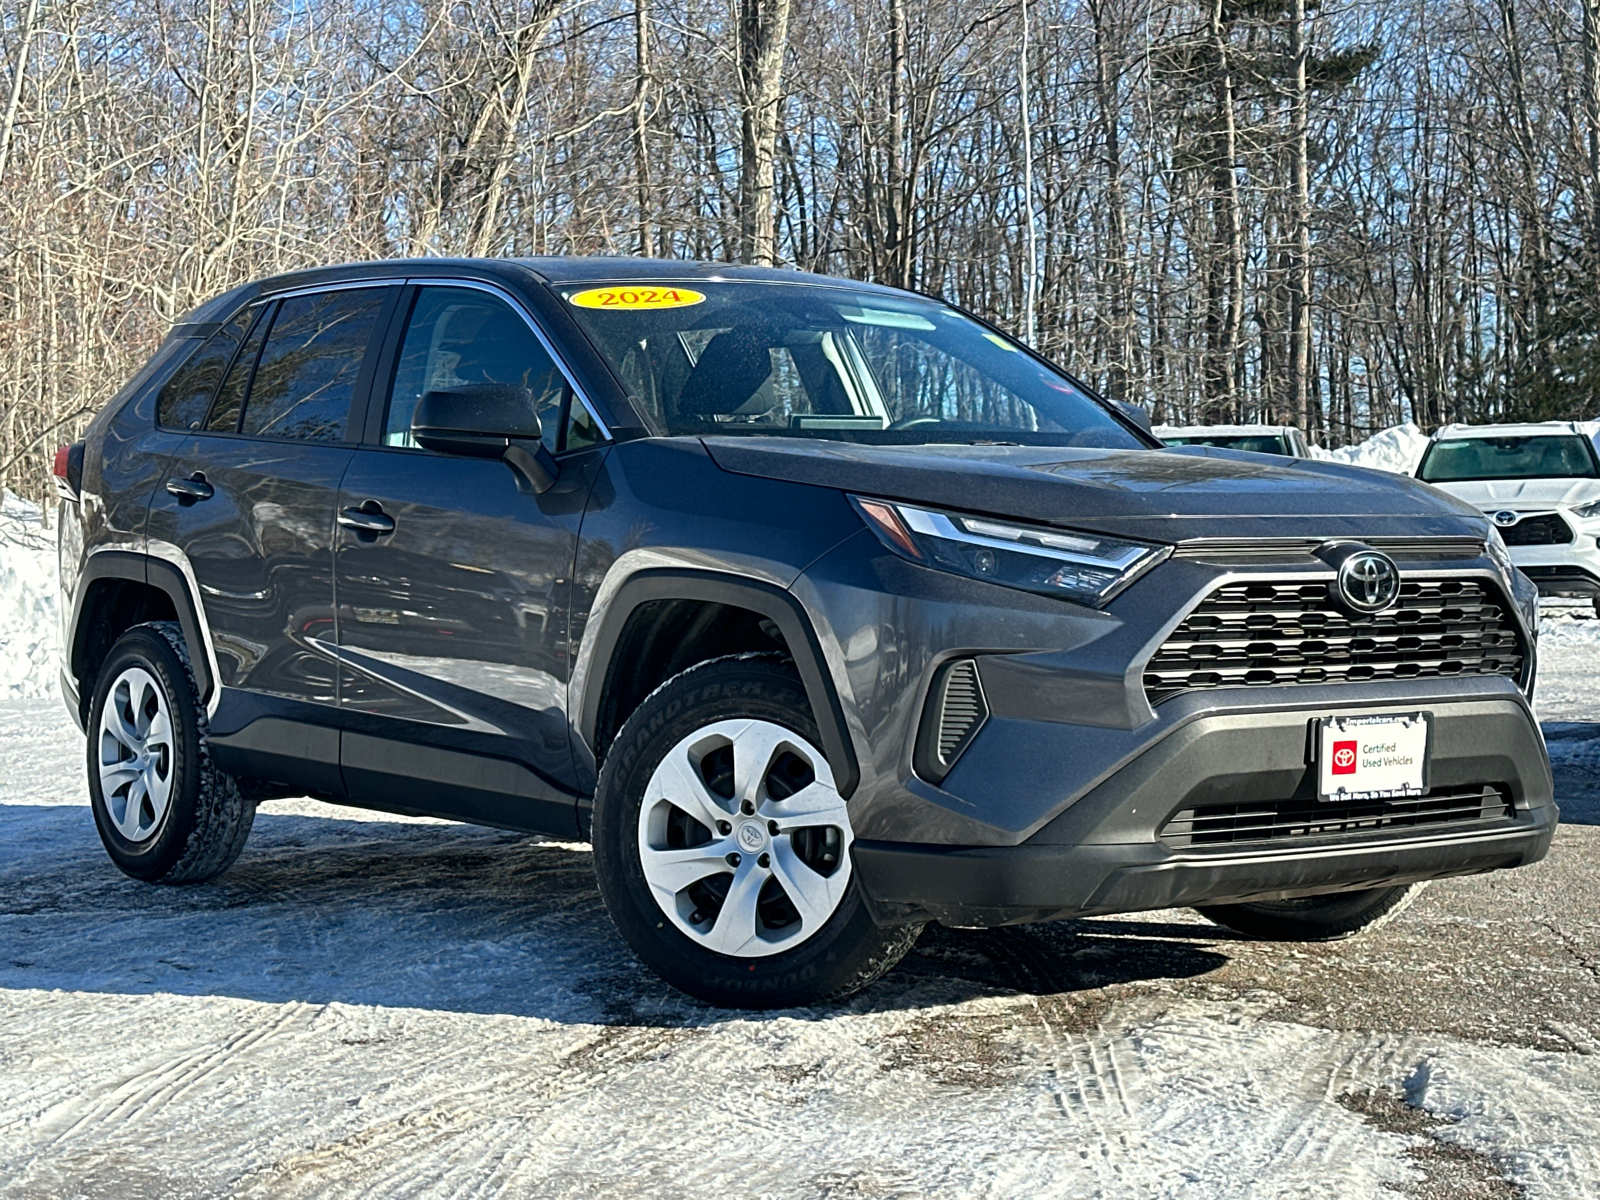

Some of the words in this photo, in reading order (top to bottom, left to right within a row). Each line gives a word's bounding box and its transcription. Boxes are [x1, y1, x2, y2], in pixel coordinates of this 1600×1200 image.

[597, 290, 684, 305] 2024
[1362, 742, 1396, 754] Certified
[1362, 758, 1381, 768] Used
[1383, 756, 1413, 766] Vehicles
[1340, 793, 1351, 801] Sell
[1370, 791, 1378, 799] So
